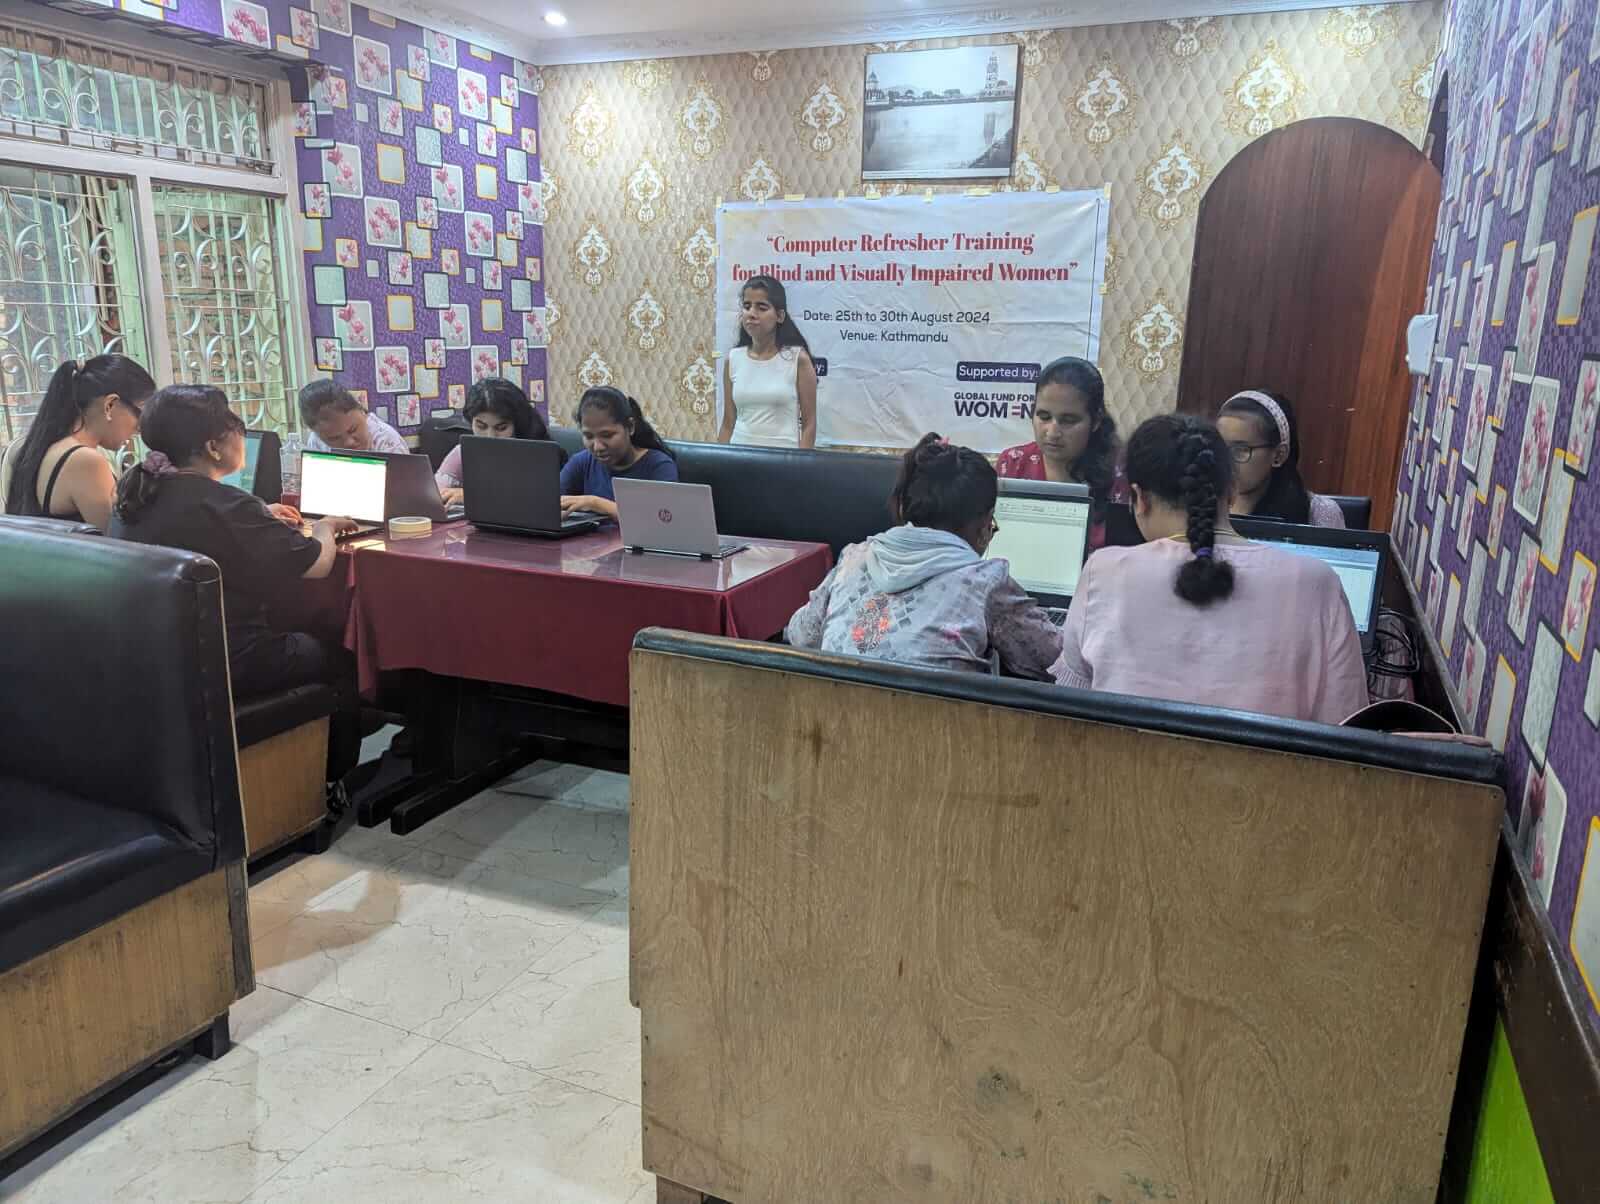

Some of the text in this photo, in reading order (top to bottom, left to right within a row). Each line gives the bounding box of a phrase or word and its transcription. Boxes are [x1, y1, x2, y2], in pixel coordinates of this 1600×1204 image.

[861, 233, 949, 251] Refresher
[952, 231, 1035, 256] Training
[732, 264, 756, 281] for
[760, 263, 801, 281] Blind
[805, 264, 835, 281] and
[840, 263, 906, 286] Visually
[911, 262, 994, 286] Impaired
[803, 310, 990, 326] Date: 25th to 30th August 2024
[840, 330, 949, 343] Venue: Kathmandu
[959, 365, 1019, 379] Supported
[954, 392, 989, 401] GLOBAL
[991, 394, 1016, 402] FUND
